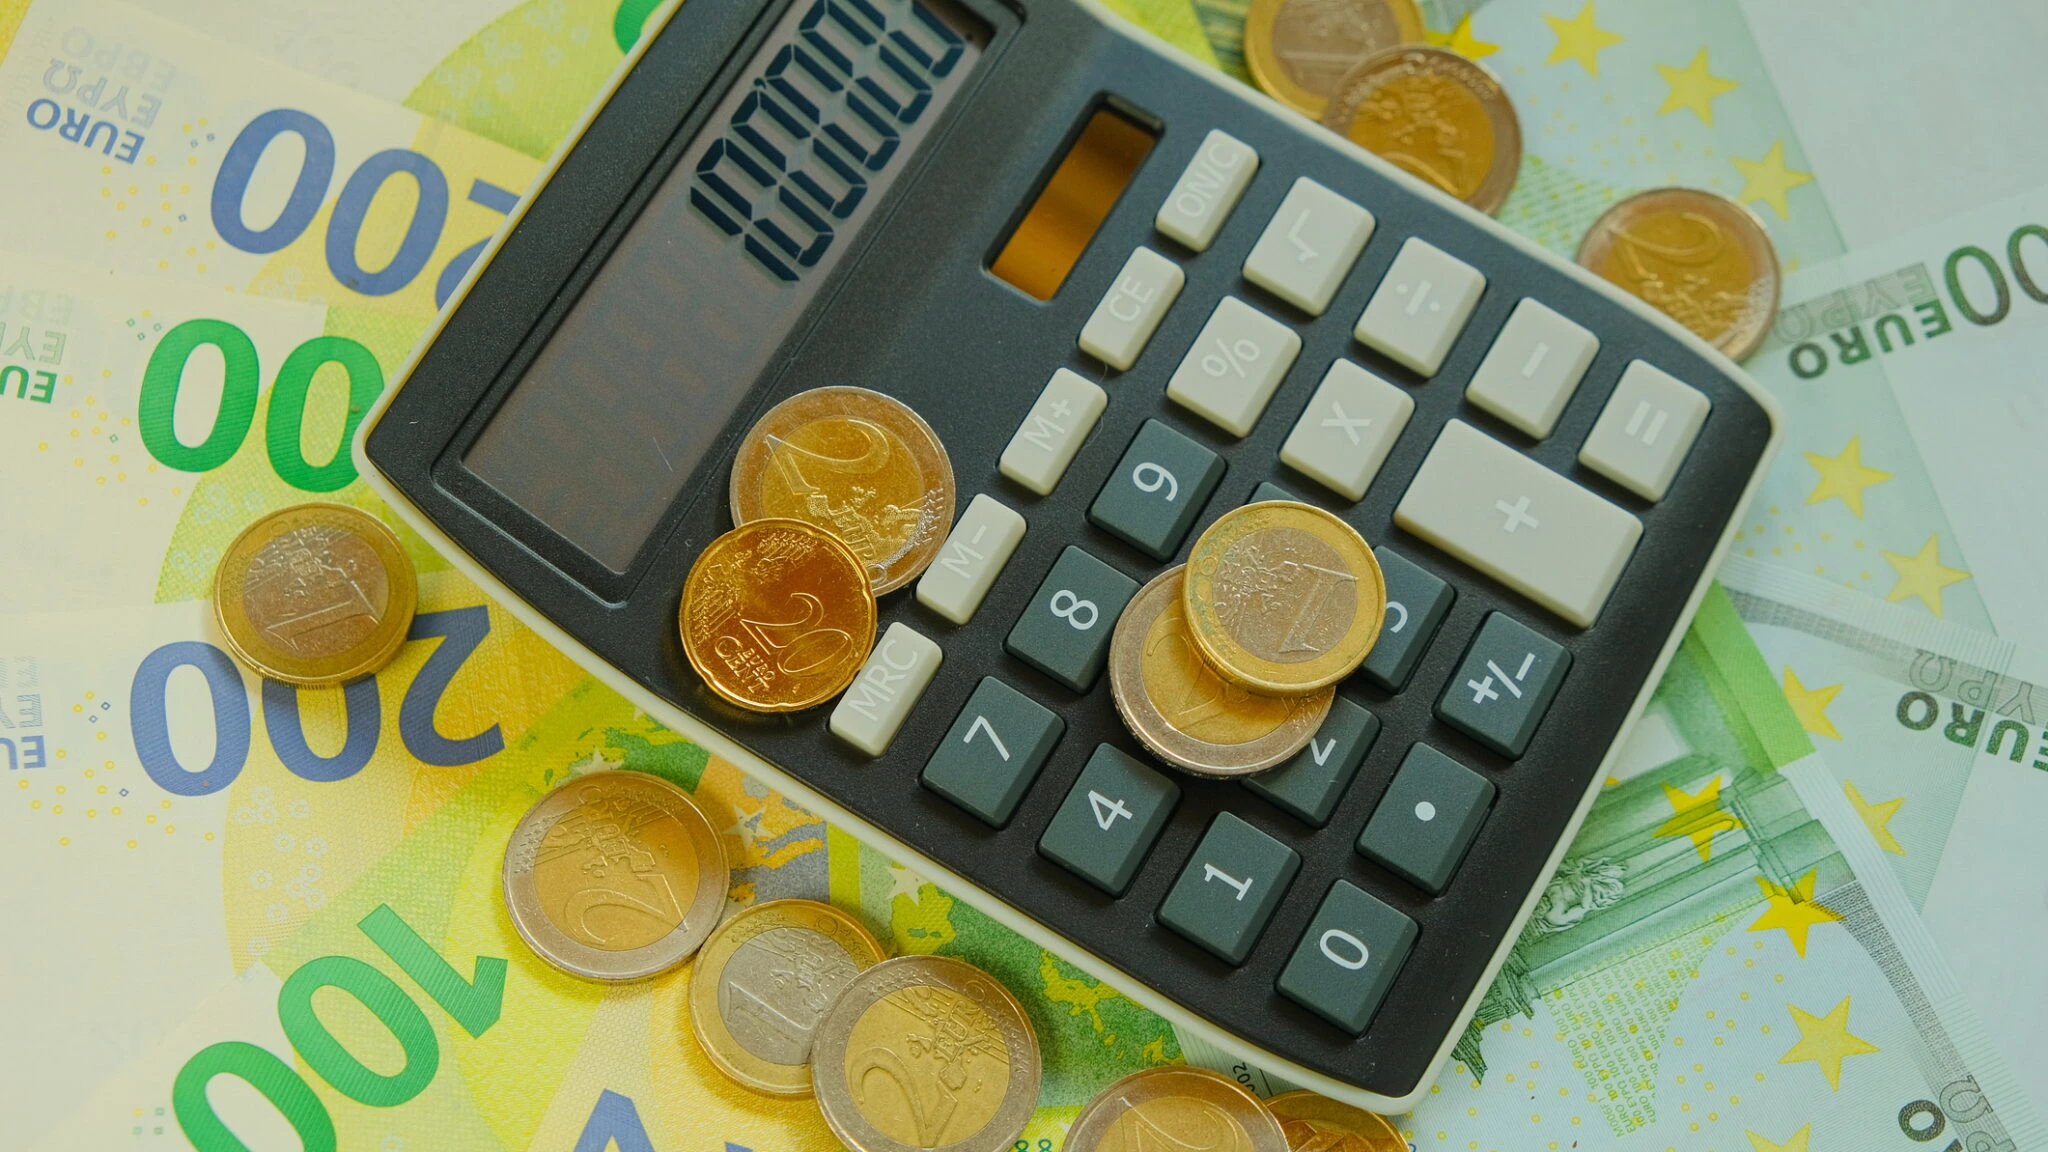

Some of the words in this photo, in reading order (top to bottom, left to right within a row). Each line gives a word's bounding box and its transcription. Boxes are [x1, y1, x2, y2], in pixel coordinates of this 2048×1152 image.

[26, 98, 146, 165] EURO
[1176, 143, 1237, 219] ON/C
[1111, 275, 1153, 322] CE
[1788, 299, 1952, 380] EURO
[1023, 396, 1072, 452] M+
[1133, 462, 1177, 501] 9
[740, 592, 854, 678] 20
[1050, 590, 1098, 630] 8
[714, 635, 771, 694] CENT
[737, 647, 776, 681] EURO
[847, 639, 919, 721] MRC
[964, 715, 1011, 761] 7
[1087, 789, 1133, 831] 4
[1204, 862, 1252, 901] 1
[1320, 929, 1369, 970] 0
[172, 903, 508, 1152] 100
